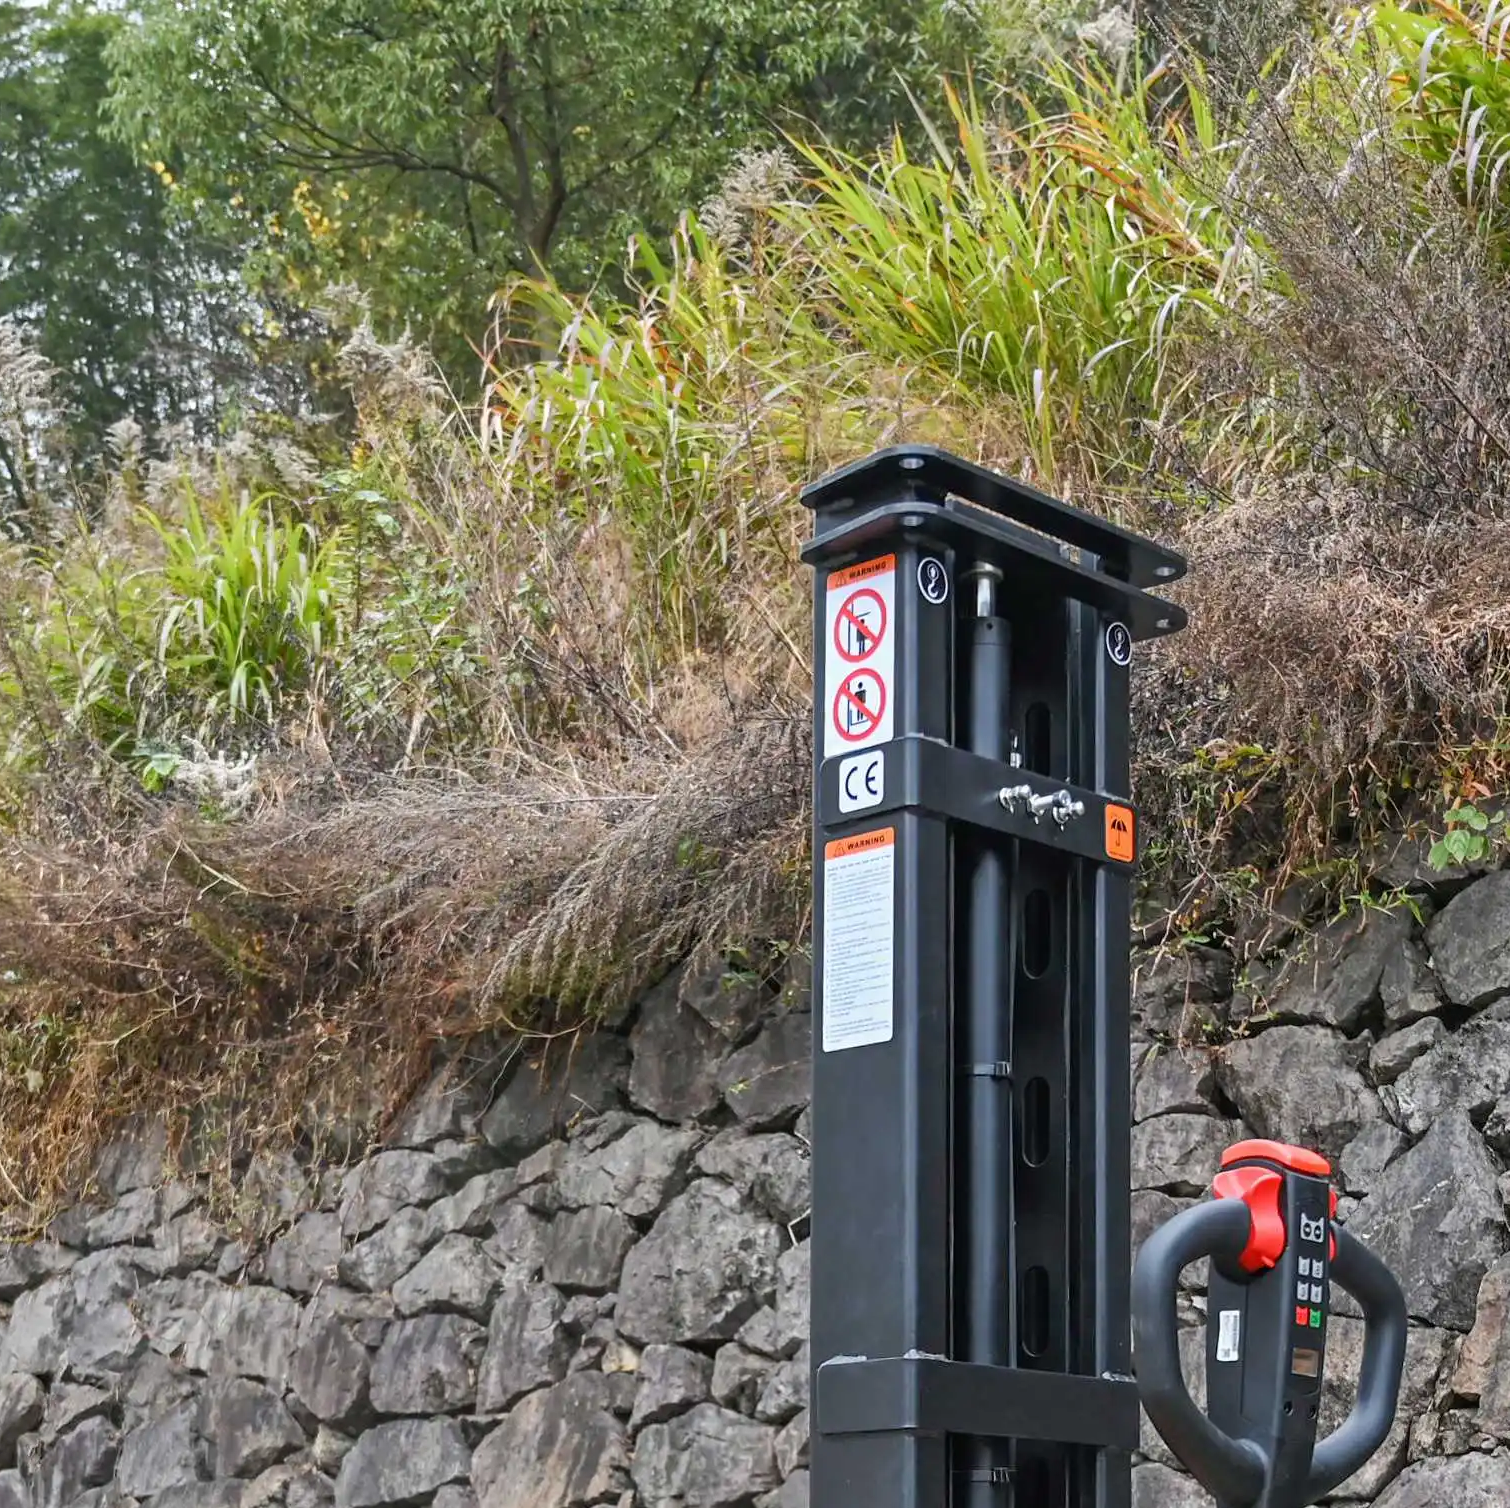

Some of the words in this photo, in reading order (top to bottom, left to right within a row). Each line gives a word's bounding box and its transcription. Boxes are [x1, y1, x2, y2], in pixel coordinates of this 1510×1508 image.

[849, 561, 887, 579] WARNING
[845, 760, 879, 801] CE
[847, 835, 885, 850] WARNING
